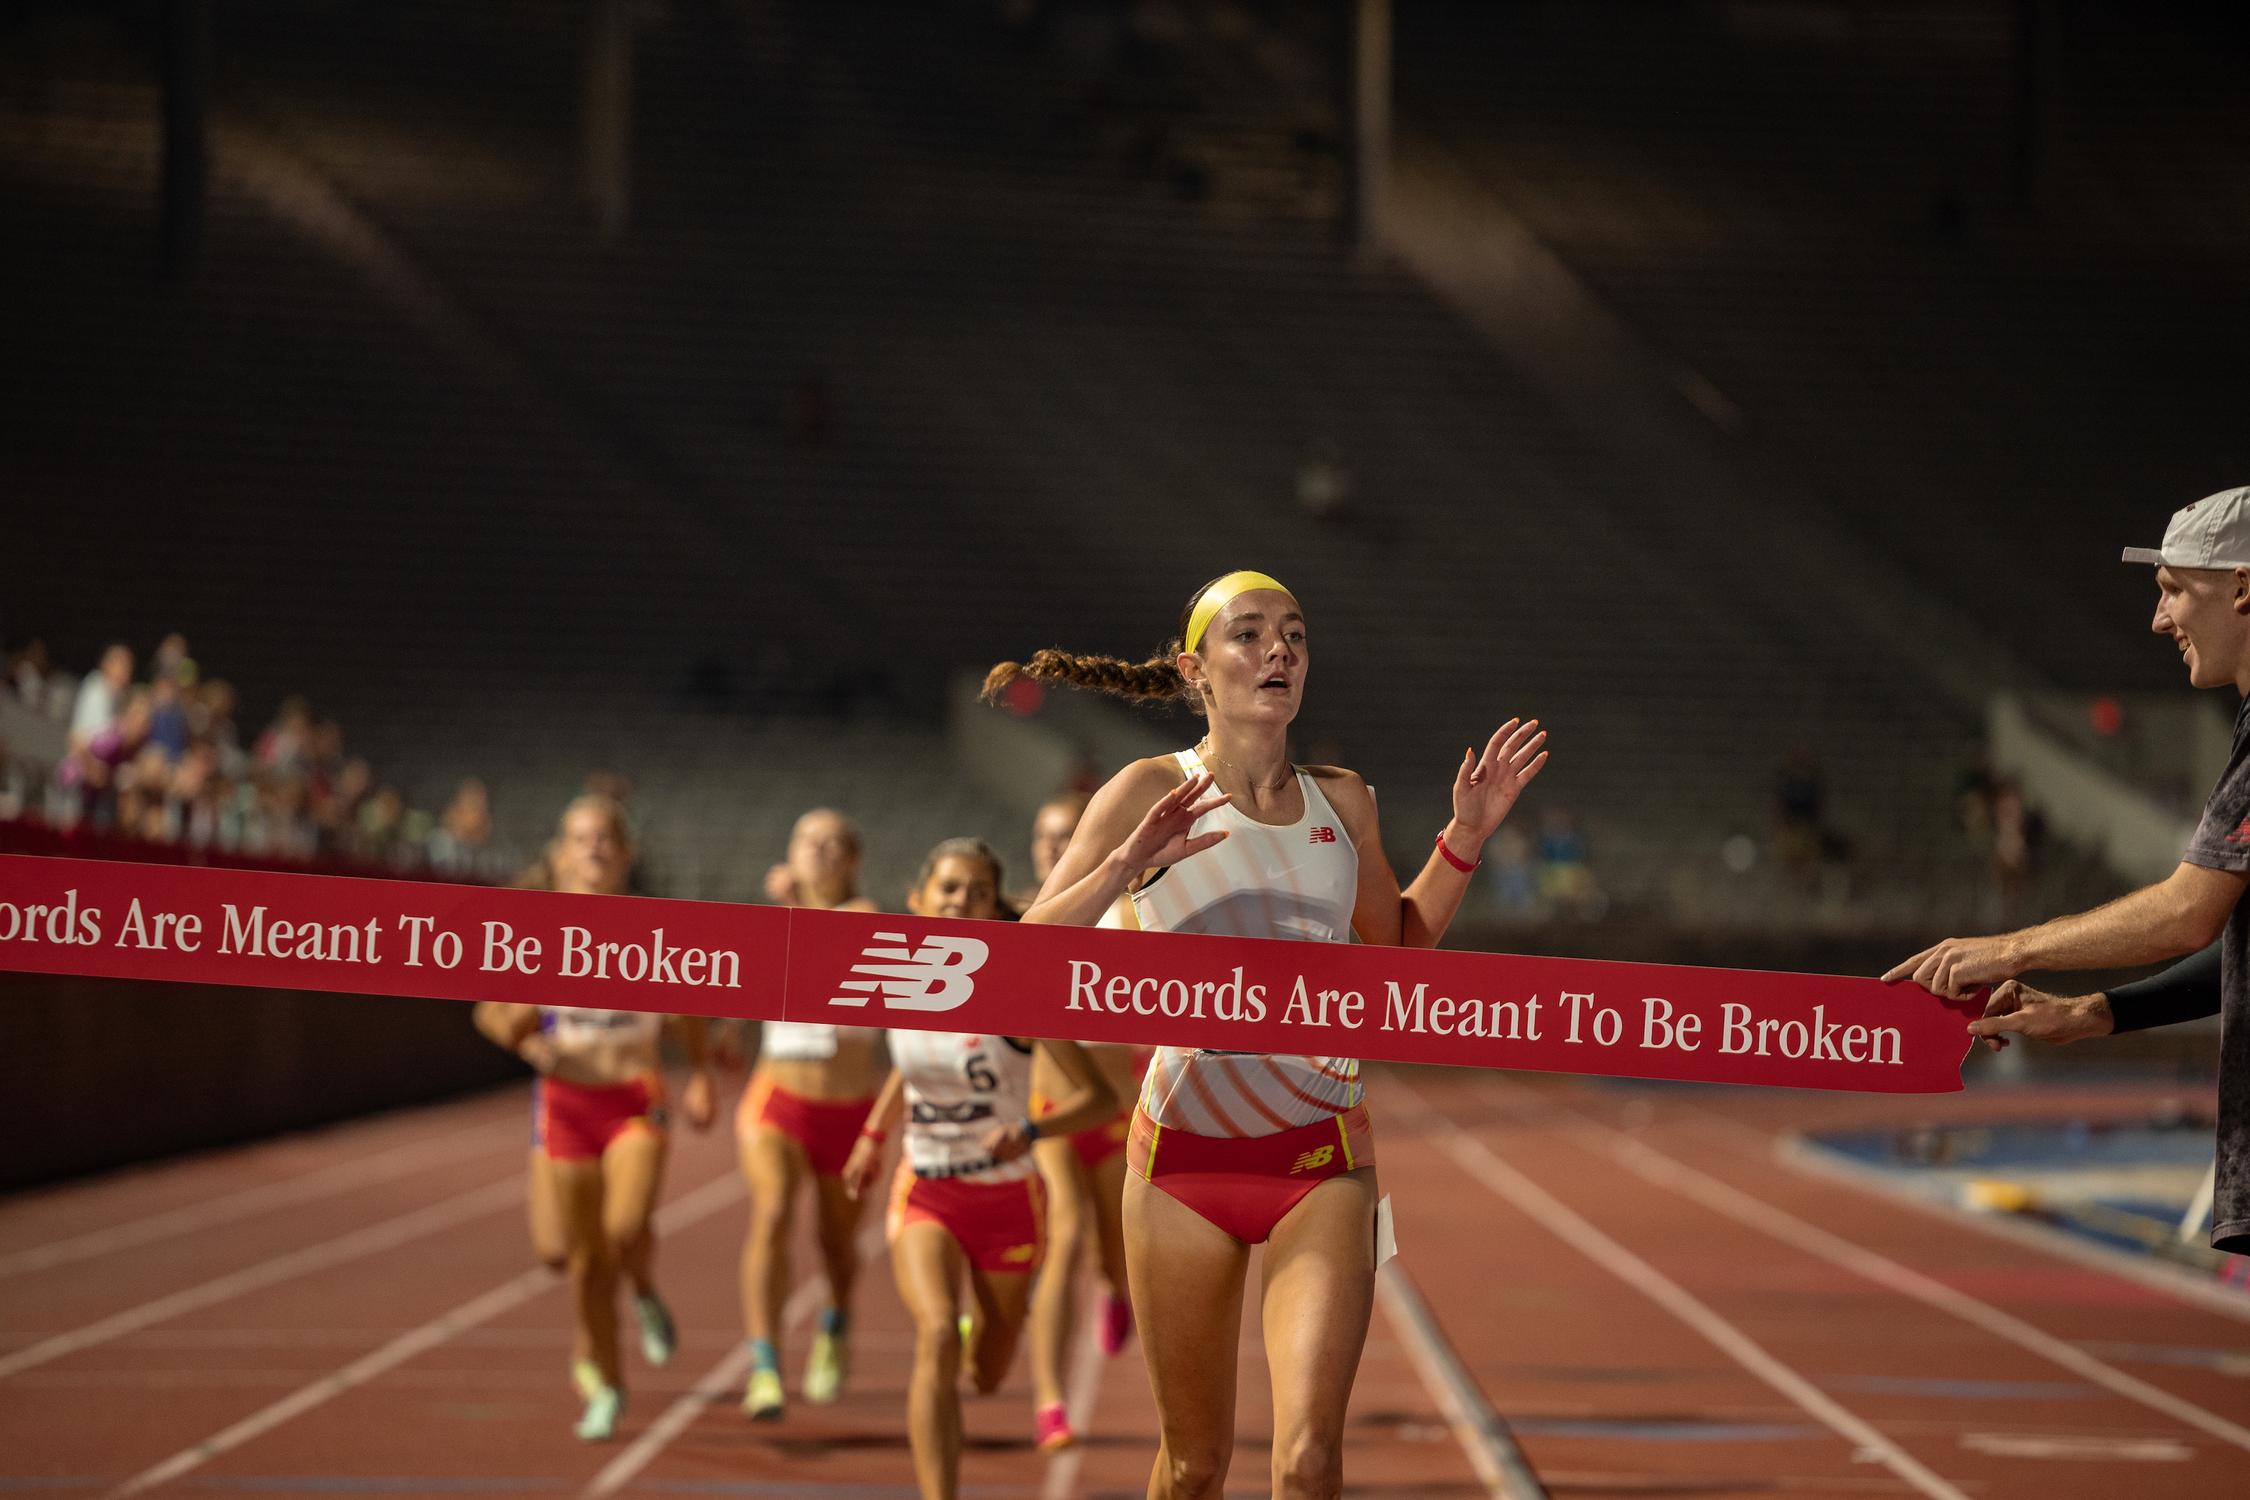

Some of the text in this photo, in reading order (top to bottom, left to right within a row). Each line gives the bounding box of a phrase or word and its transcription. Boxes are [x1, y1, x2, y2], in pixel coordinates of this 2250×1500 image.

[115, 898, 201, 952] Are
[217, 904, 382, 964] Meant
[399, 914, 463, 969] To
[479, 921, 541, 974] Be
[558, 927, 742, 988] Broken
[828, 932, 989, 1011] NB
[1065, 960, 1903, 1065] Records Are Meant To Be Broken
